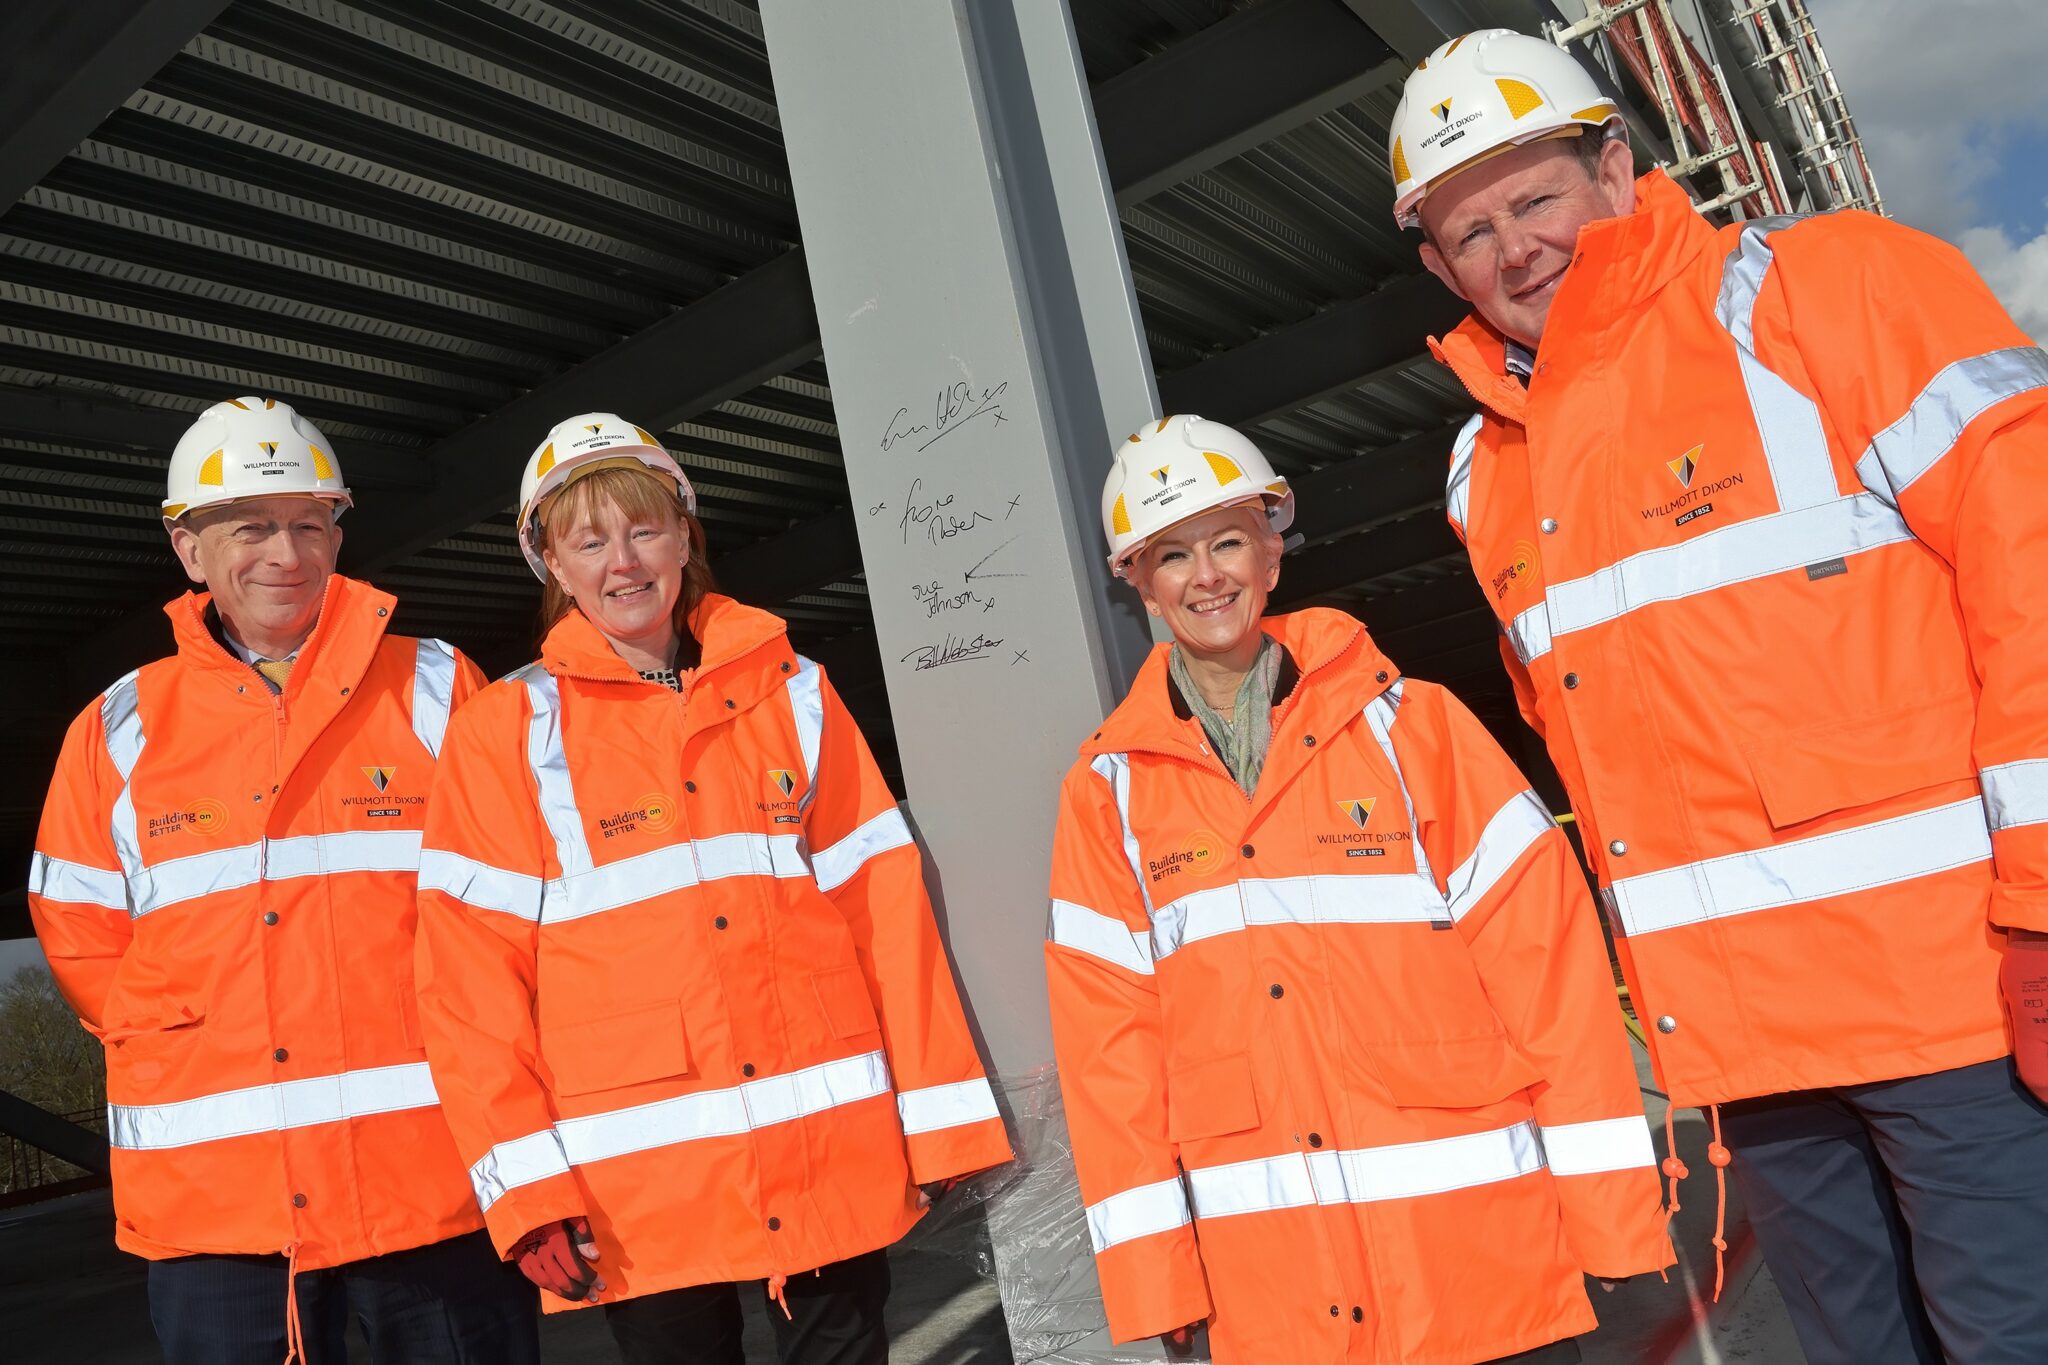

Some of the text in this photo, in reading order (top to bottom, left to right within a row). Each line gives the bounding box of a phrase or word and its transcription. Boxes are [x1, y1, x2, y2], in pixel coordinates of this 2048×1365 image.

[1420, 110, 1483, 149] WILLMOTT DIXON
[571, 435, 603, 448] WILLMOTT
[243, 461, 277, 469] WILLMOTT
[1141, 486, 1173, 506] WILLMOTT
[1174, 477, 1197, 491] DIXON
[1641, 473, 1744, 520] WILLMOTT DIXON
[1677, 505, 1711, 525] SINCE 1852
[1516, 562, 1526, 571] on
[341, 796, 425, 806] WILLMOTT DIXON
[149, 812, 196, 829] Building
[600, 807, 661, 830] Building on
[149, 823, 182, 838] BETTER
[603, 823, 636, 839] BETTER
[1316, 831, 1411, 844] WILLMOTT DIXON
[1149, 849, 1208, 873] Building on
[1348, 849, 1367, 857] SINCE
[1152, 864, 1181, 882] BETTER
